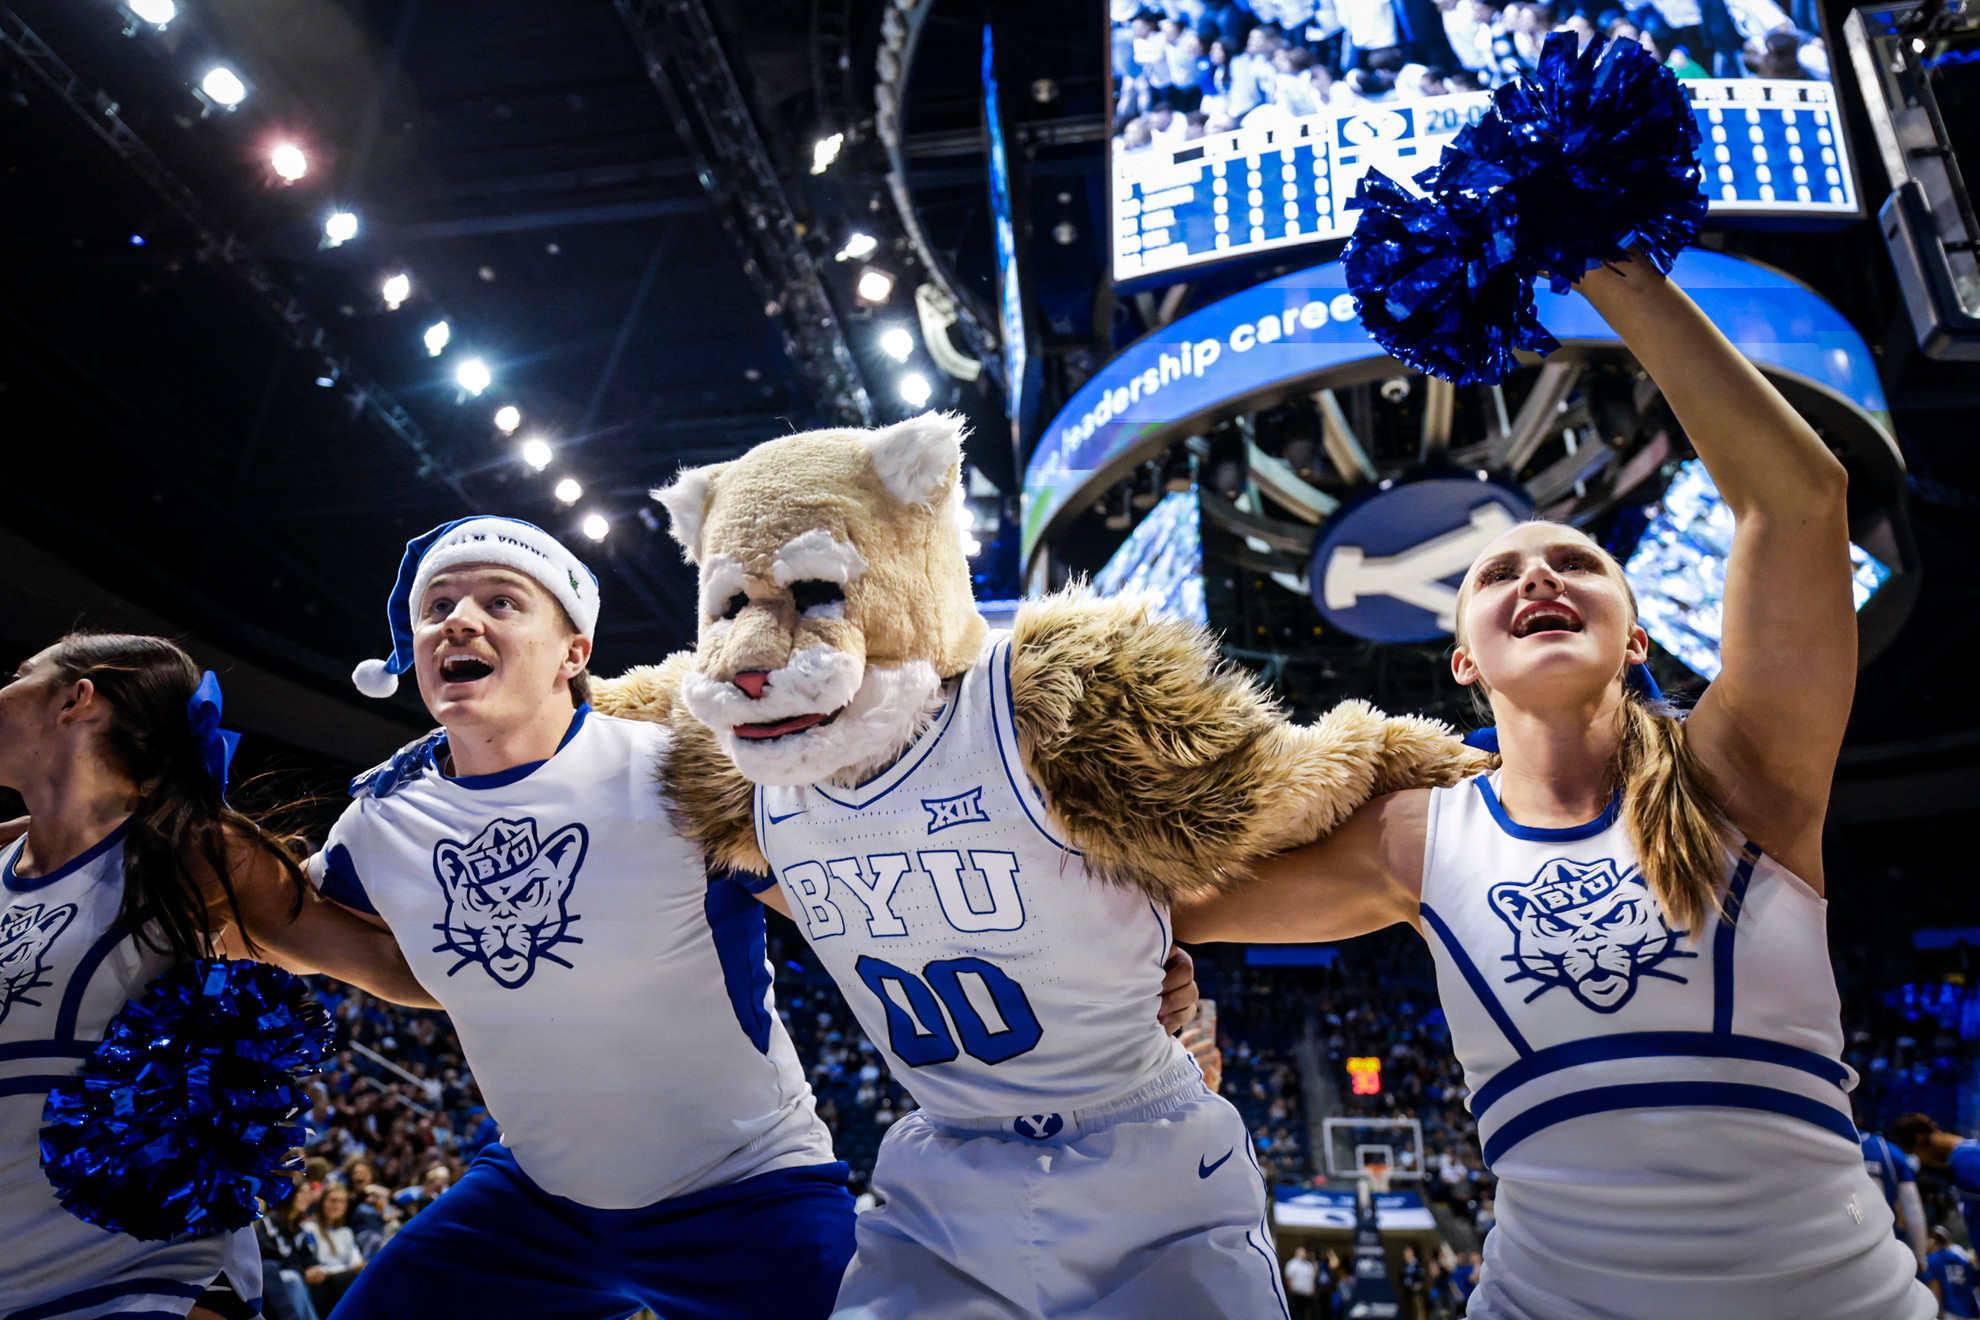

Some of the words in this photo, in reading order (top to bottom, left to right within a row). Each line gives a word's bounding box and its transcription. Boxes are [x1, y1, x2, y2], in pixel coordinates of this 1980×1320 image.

[1061, 338, 1221, 458] leadership
[474, 841, 530, 880] BYU
[1541, 875, 1609, 909] BYU
[782, 849, 1026, 941] BYU
[855, 954, 1044, 1068] 00
[1020, 1115, 1053, 1138] Y
